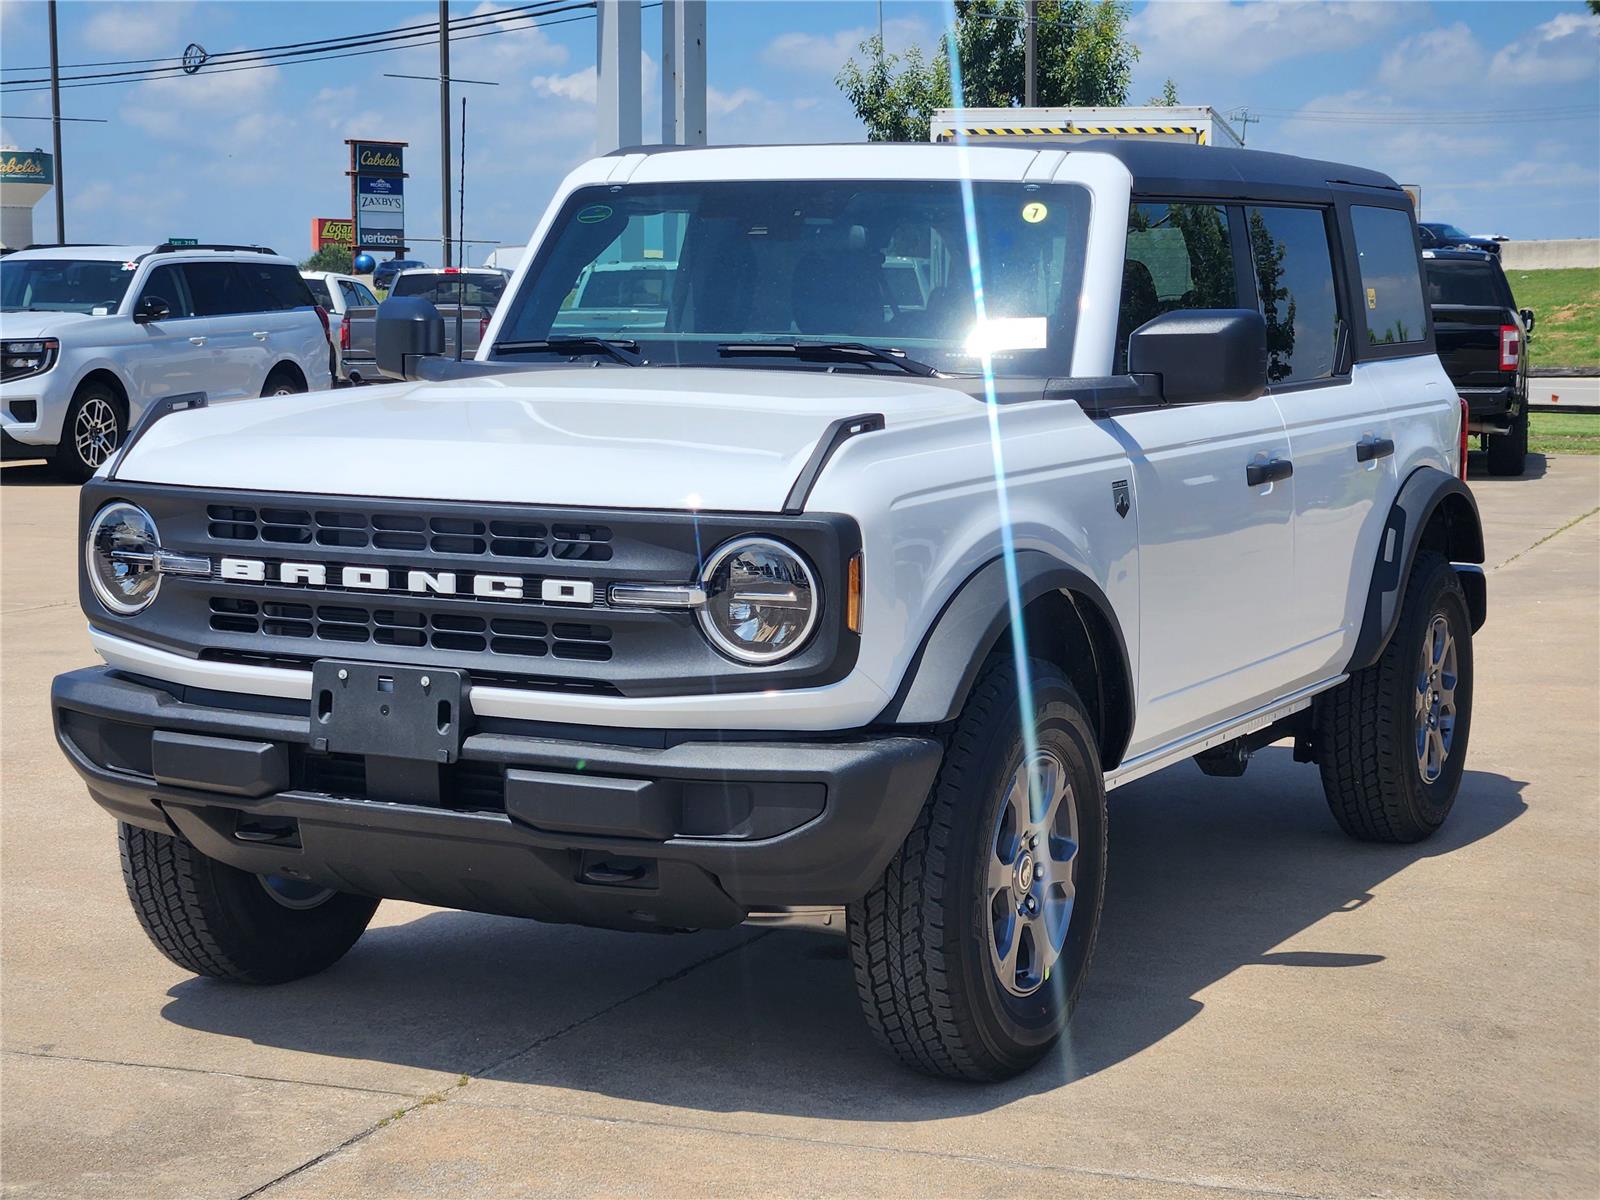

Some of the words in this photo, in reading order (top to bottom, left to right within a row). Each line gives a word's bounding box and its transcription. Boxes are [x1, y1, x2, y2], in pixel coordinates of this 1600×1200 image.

[360, 150, 400, 167] Cabela's
[361, 196, 401, 208] ZAXBY'S
[1031, 207, 1039, 219] 7
[361, 232, 398, 244] verizon
[220, 558, 594, 603] BRONCO
